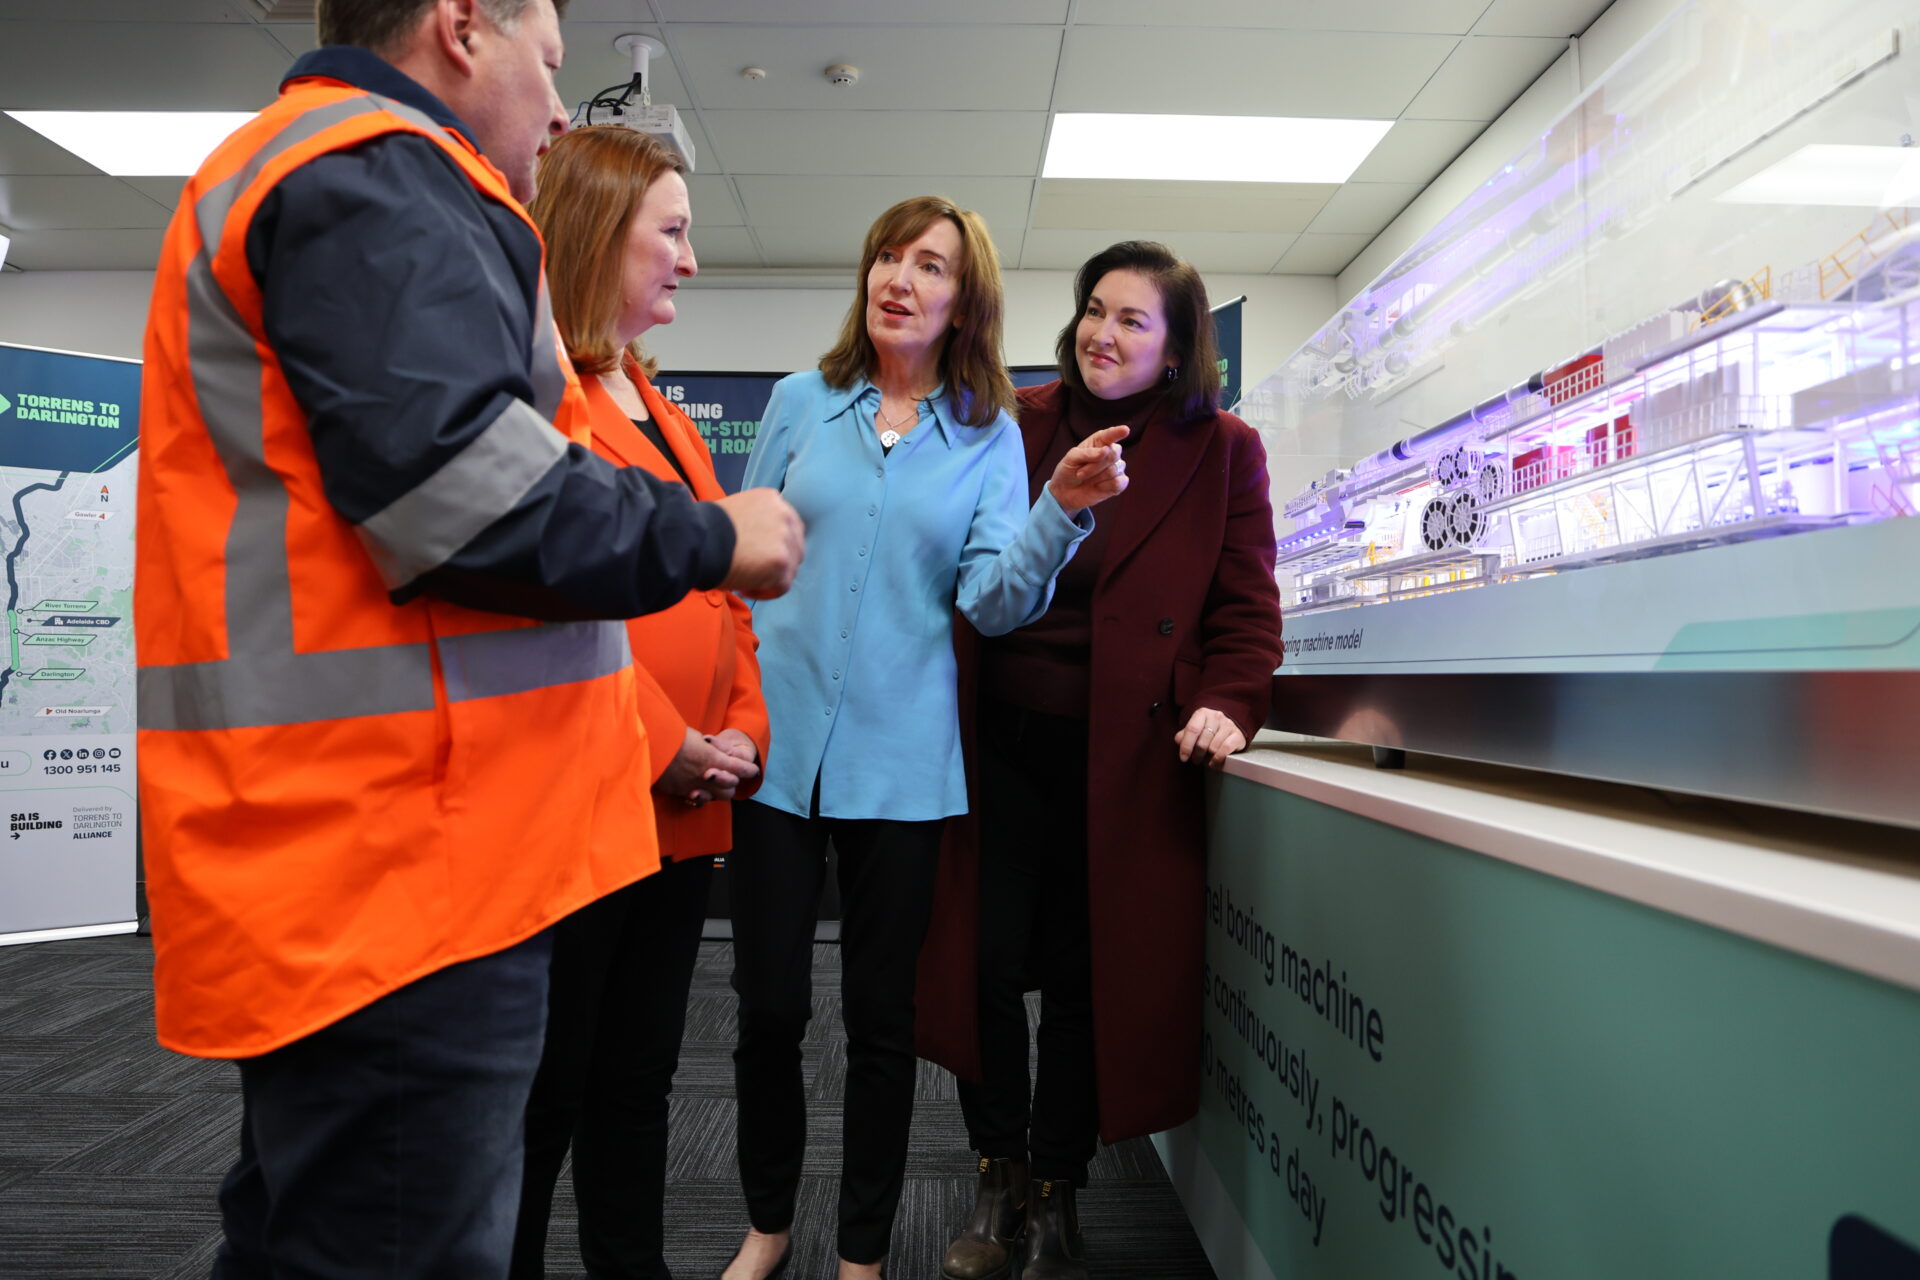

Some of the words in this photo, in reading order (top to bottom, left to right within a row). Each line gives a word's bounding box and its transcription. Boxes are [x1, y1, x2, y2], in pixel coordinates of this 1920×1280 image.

[666, 385, 685, 401] IS
[17, 393, 94, 413] TORRENS
[99, 402, 120, 416] TO
[17, 407, 120, 429] DARLINGTON
[694, 421, 761, 437] N-STO
[1302, 632, 1334, 652] machine
[1335, 628, 1364, 649] model
[44, 765, 73, 775] 1300
[77, 764, 97, 774] 951
[101, 764, 121, 773] 145
[10, 813, 26, 822] SA
[28, 812, 39, 821] IS
[73, 813, 110, 822] TORRENS
[112, 812, 122, 820] TO
[73, 820, 122, 830] DARLINGTON
[10, 820, 63, 831] BUILDING
[73, 831, 112, 840] ALLIANCE
[1227, 889, 1275, 986] boring
[1281, 941, 1384, 1062] machine
[1214, 973, 1323, 1135] continuously,
[1216, 1057, 1265, 1154] metres
[1271, 1132, 1279, 1177] a
[1287, 1147, 1326, 1247] day
